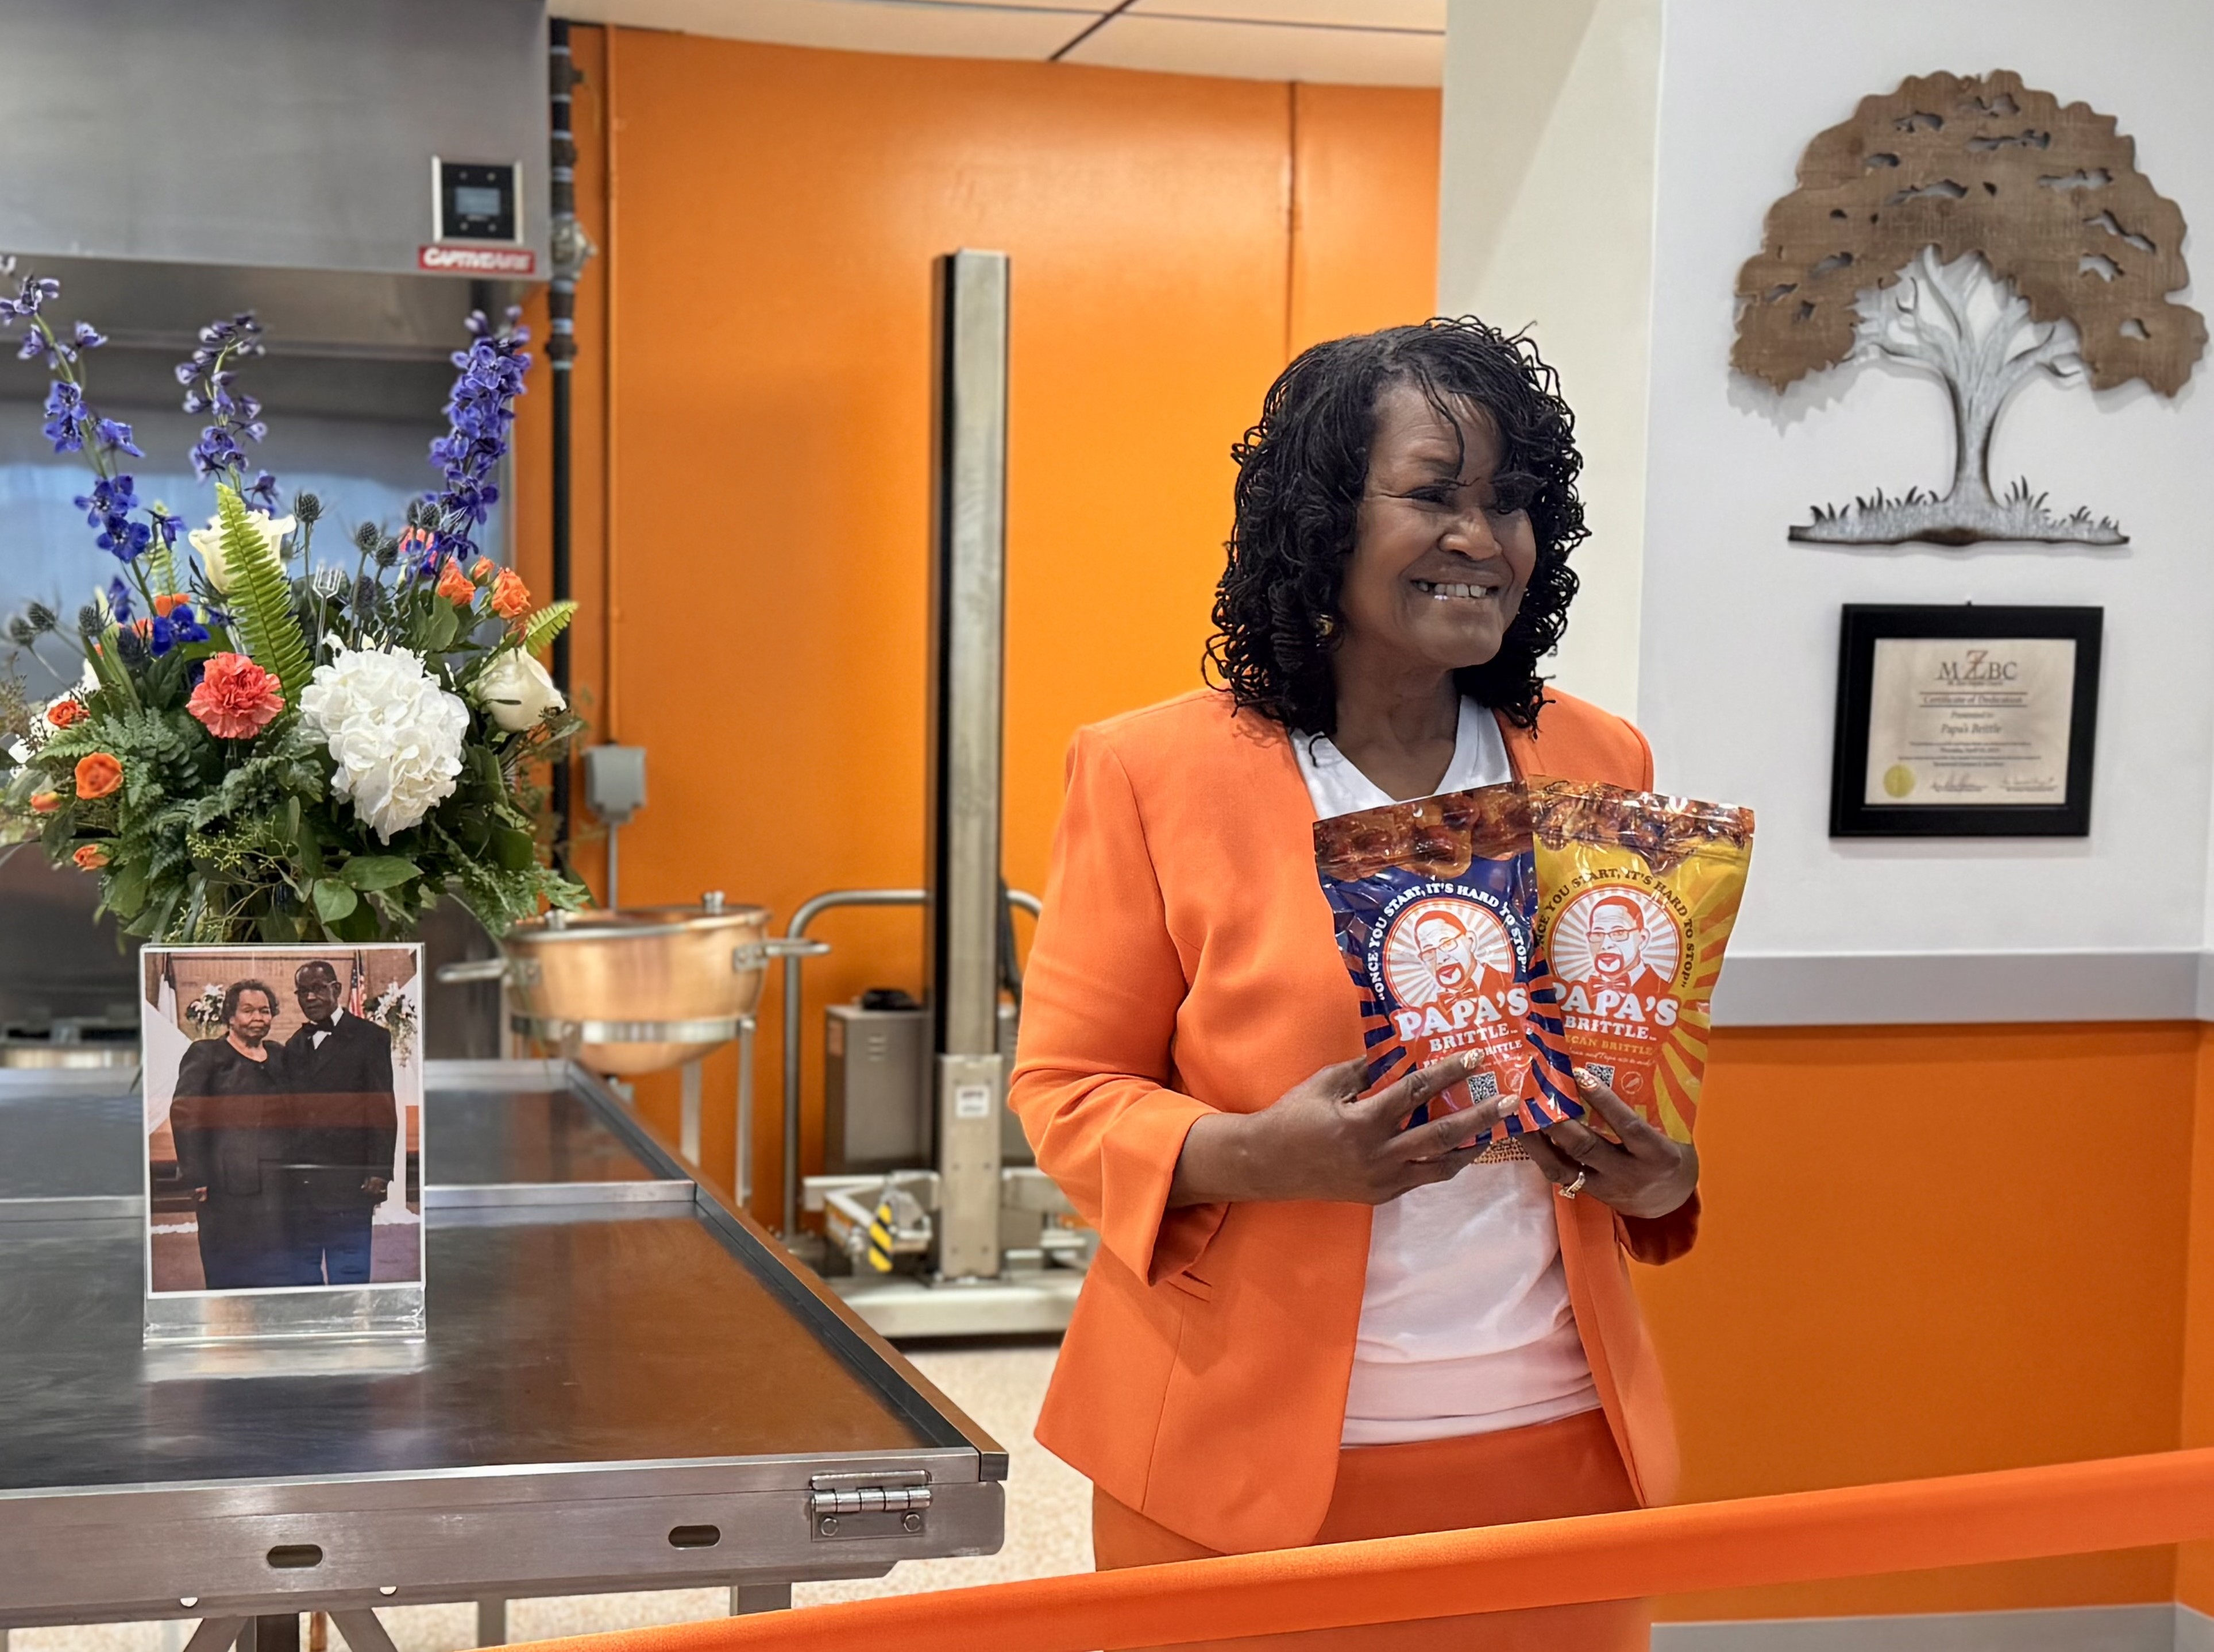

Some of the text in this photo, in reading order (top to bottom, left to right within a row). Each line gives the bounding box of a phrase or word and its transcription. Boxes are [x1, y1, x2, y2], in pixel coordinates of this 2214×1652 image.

[1368, 917, 1387, 948] YOU
[1383, 885, 1426, 917] START,
[1425, 882, 1455, 894] IT'S
[1457, 885, 1500, 908] HARD
[1499, 902, 1516, 926] TO
[1545, 885, 1570, 912] YOU
[1625, 870, 1653, 886] IT'S
[1653, 881, 1688, 917] HARD
[1683, 918, 1694, 939] TO
[1394, 987, 1529, 1042] PAPA'S
[1552, 982, 1679, 1027] PAPA'S
[1429, 1022, 1510, 1053] BRITTLE
[1564, 1015, 1649, 1041] BRITTLE
[1601, 1039, 1653, 1056] BRITTLE
